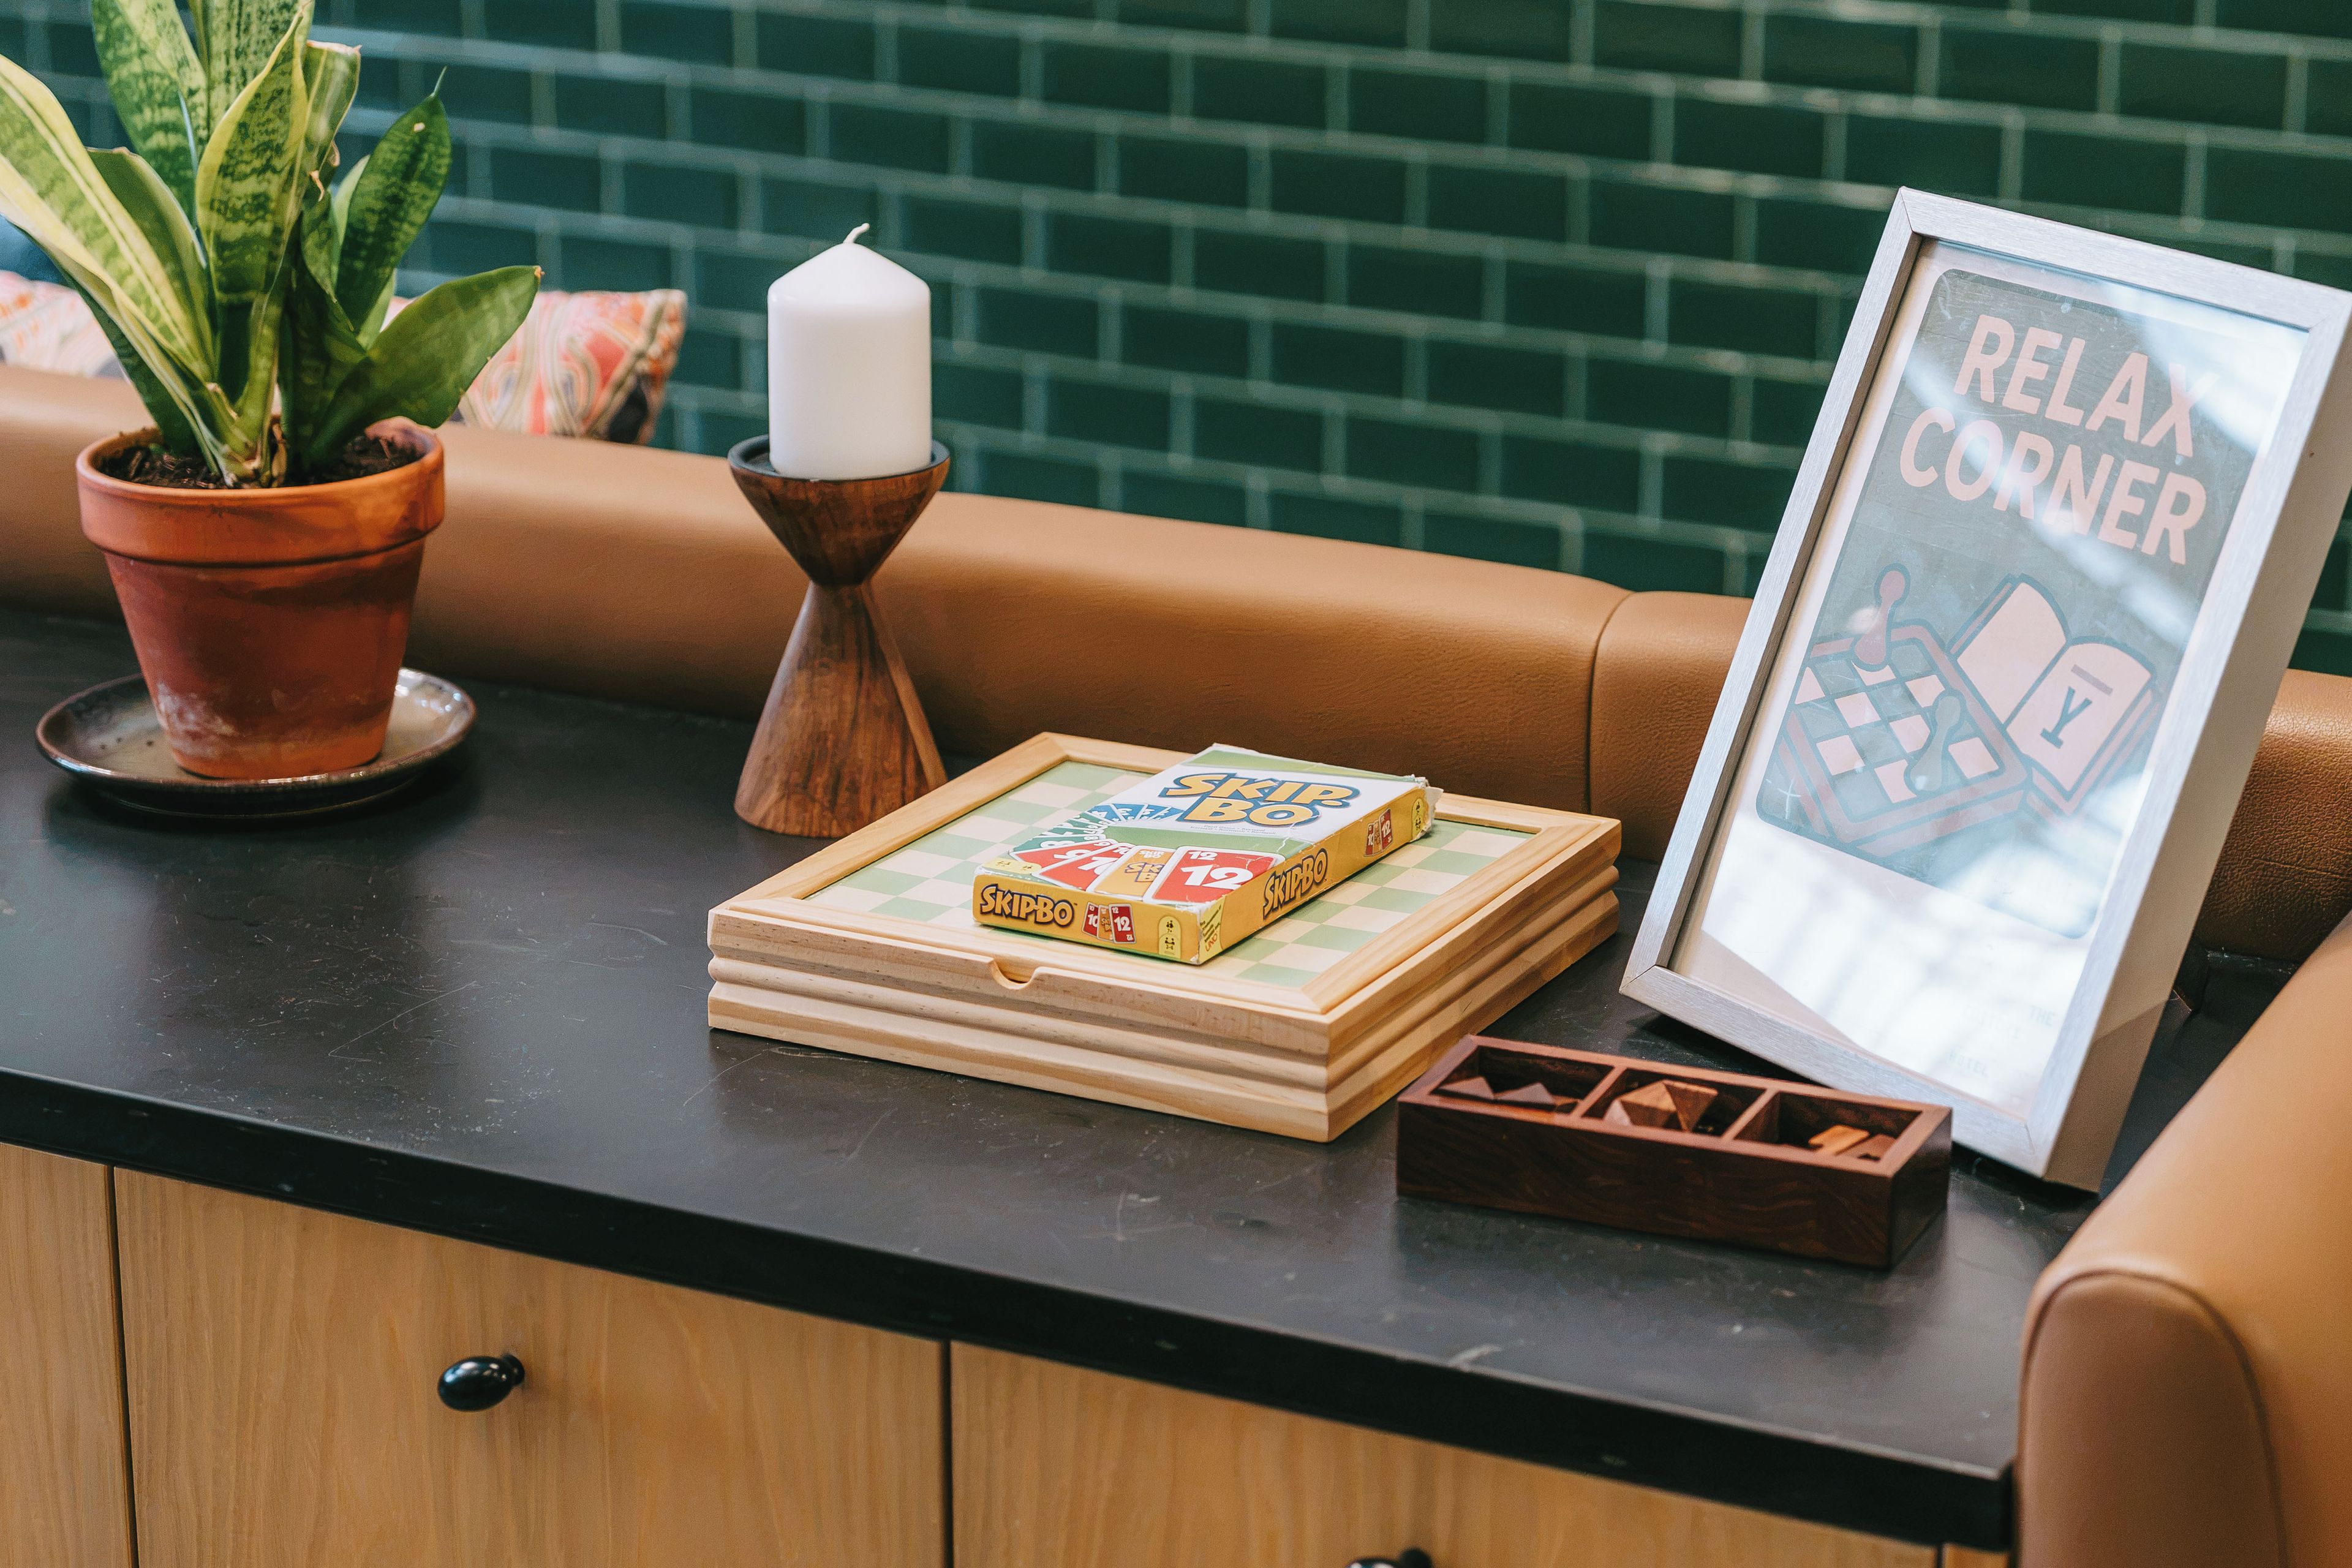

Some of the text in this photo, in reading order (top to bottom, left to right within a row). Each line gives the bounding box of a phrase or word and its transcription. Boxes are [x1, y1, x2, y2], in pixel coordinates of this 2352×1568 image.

[1954, 314, 2220, 458] RELAX
[1900, 407, 2206, 565] CORNER
[2040, 686, 2093, 749] Y
[1179, 796, 1319, 826] BO
[1381, 820, 1391, 839] 12
[1125, 862, 1165, 873] SK
[1188, 851, 1218, 861] 12
[1180, 864, 1254, 890] 12
[1114, 916, 1131, 931] 12
[2029, 1005, 2056, 1027] THE
[1948, 1050, 1988, 1077] HOTEL
